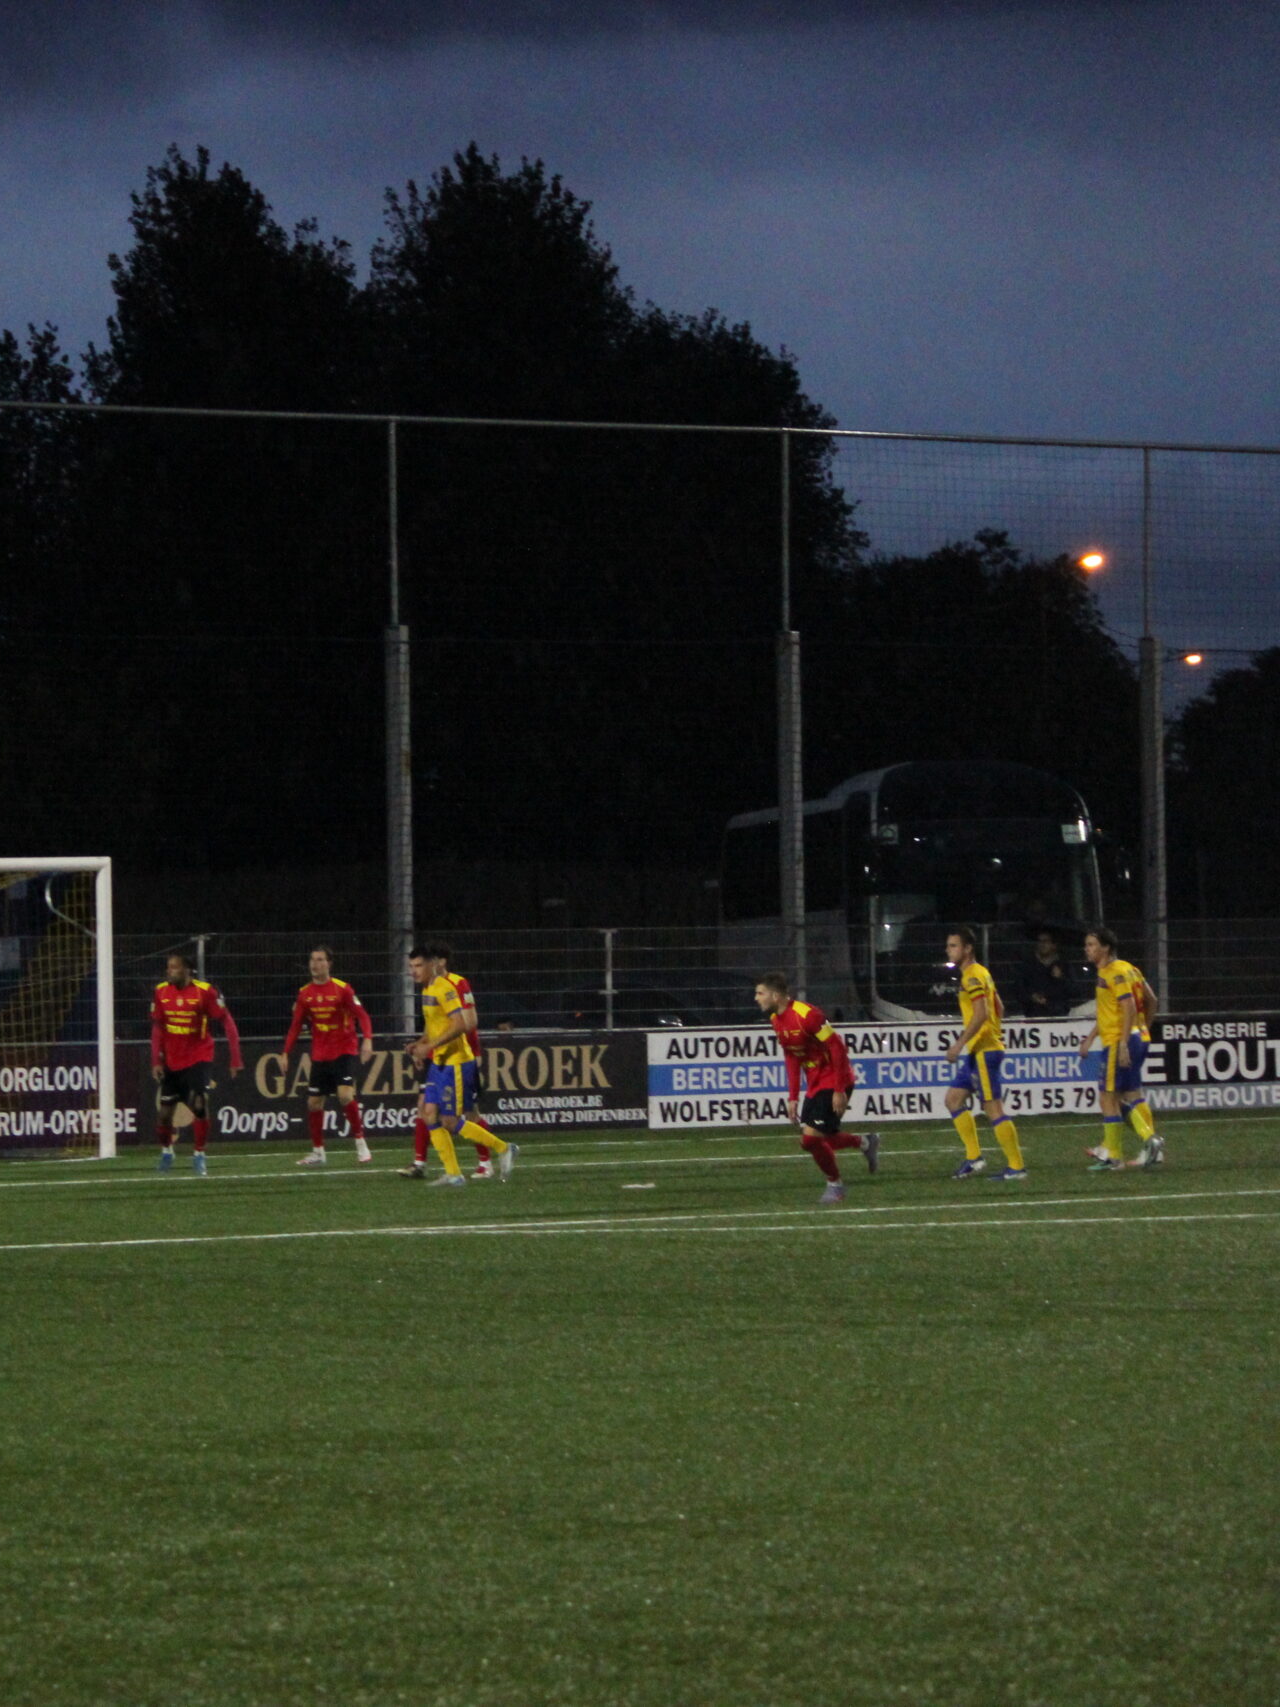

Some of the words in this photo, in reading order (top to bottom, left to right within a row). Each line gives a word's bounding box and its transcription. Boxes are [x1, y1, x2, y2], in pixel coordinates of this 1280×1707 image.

[1162, 1022, 1267, 1040] BRASSERIE
[667, 1037, 779, 1059] AUTOMAT
[846, 1031, 928, 1054] RAYING
[497, 1095, 603, 1111] GANZENBROEK.BE
[864, 1093, 932, 1116] ALKEN
[1042, 1089, 1064, 1110] 55
[1073, 1087, 1095, 1108] 79
[576, 1108, 647, 1122] DIEPENBEEK
